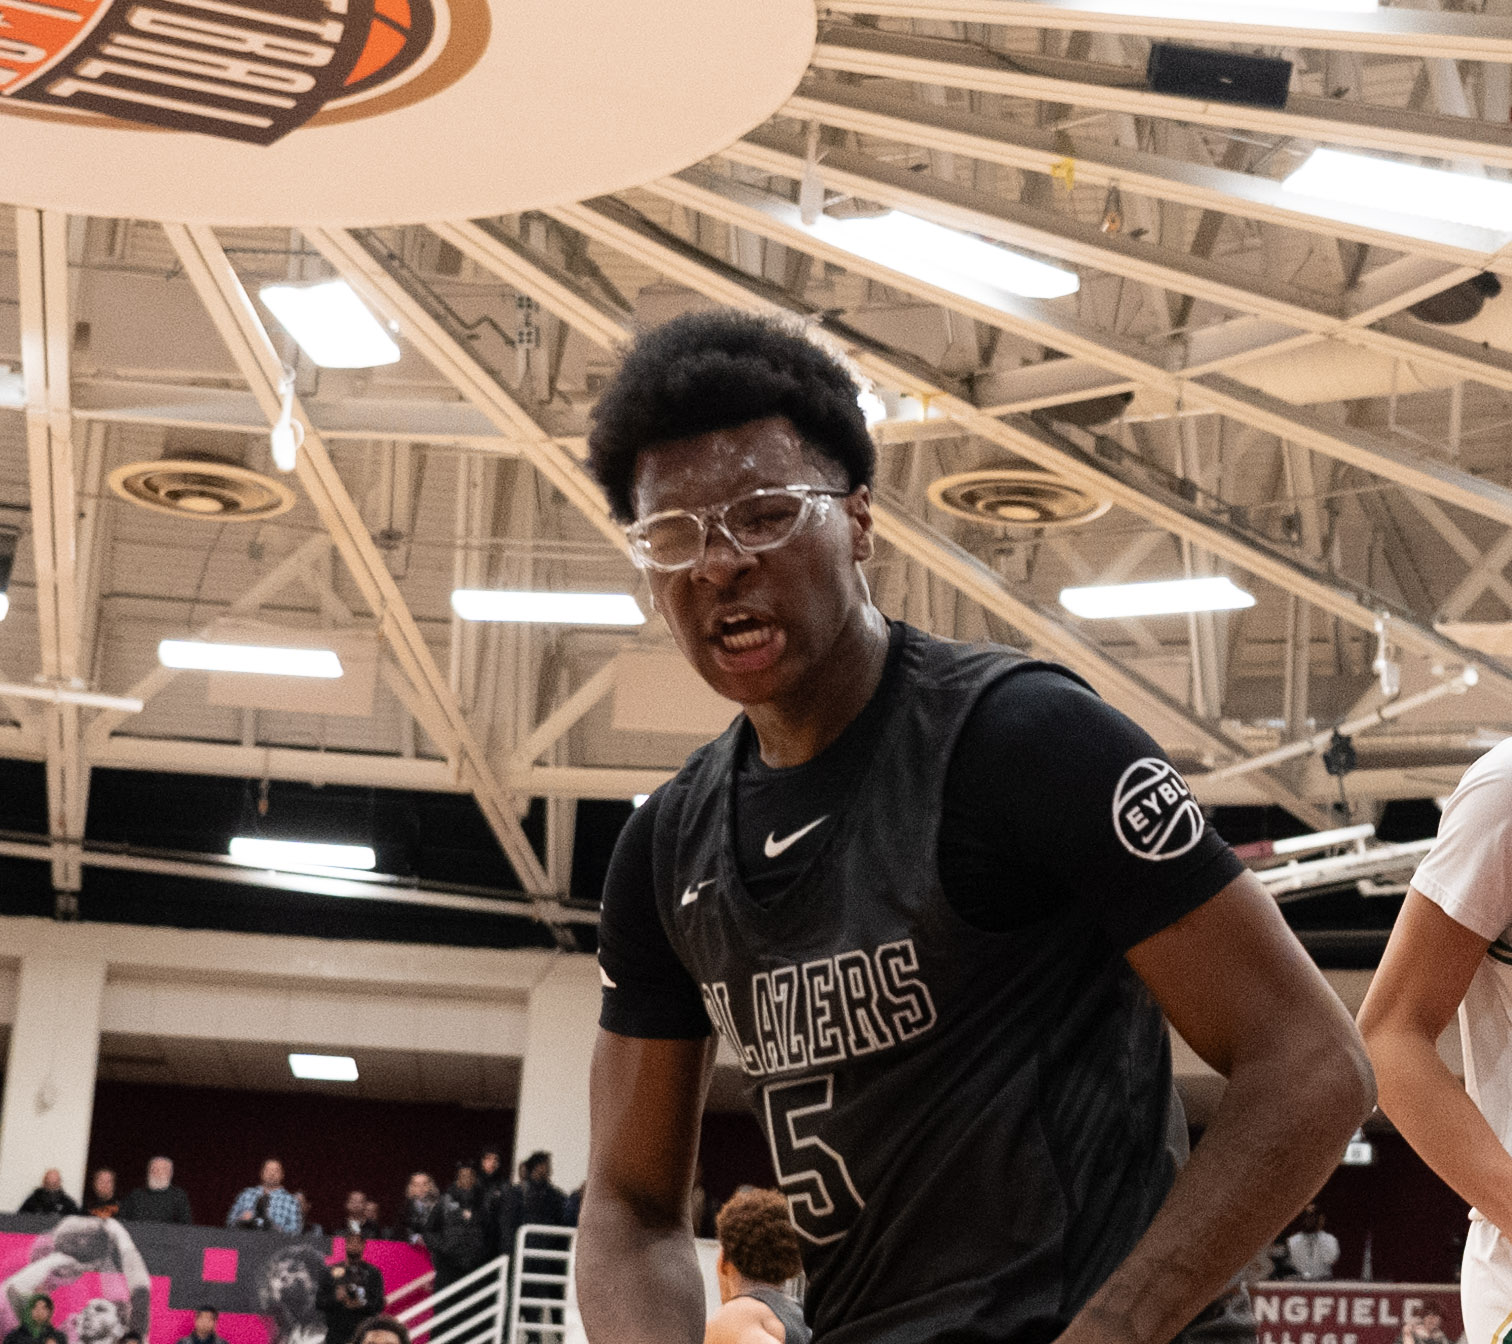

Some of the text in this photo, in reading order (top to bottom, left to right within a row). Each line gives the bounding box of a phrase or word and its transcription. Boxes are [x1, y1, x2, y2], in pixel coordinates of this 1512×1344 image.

[1125, 777, 1189, 832] EYBL
[763, 1072, 867, 1246] 5
[1253, 1296, 1425, 1326] NGFIEL
